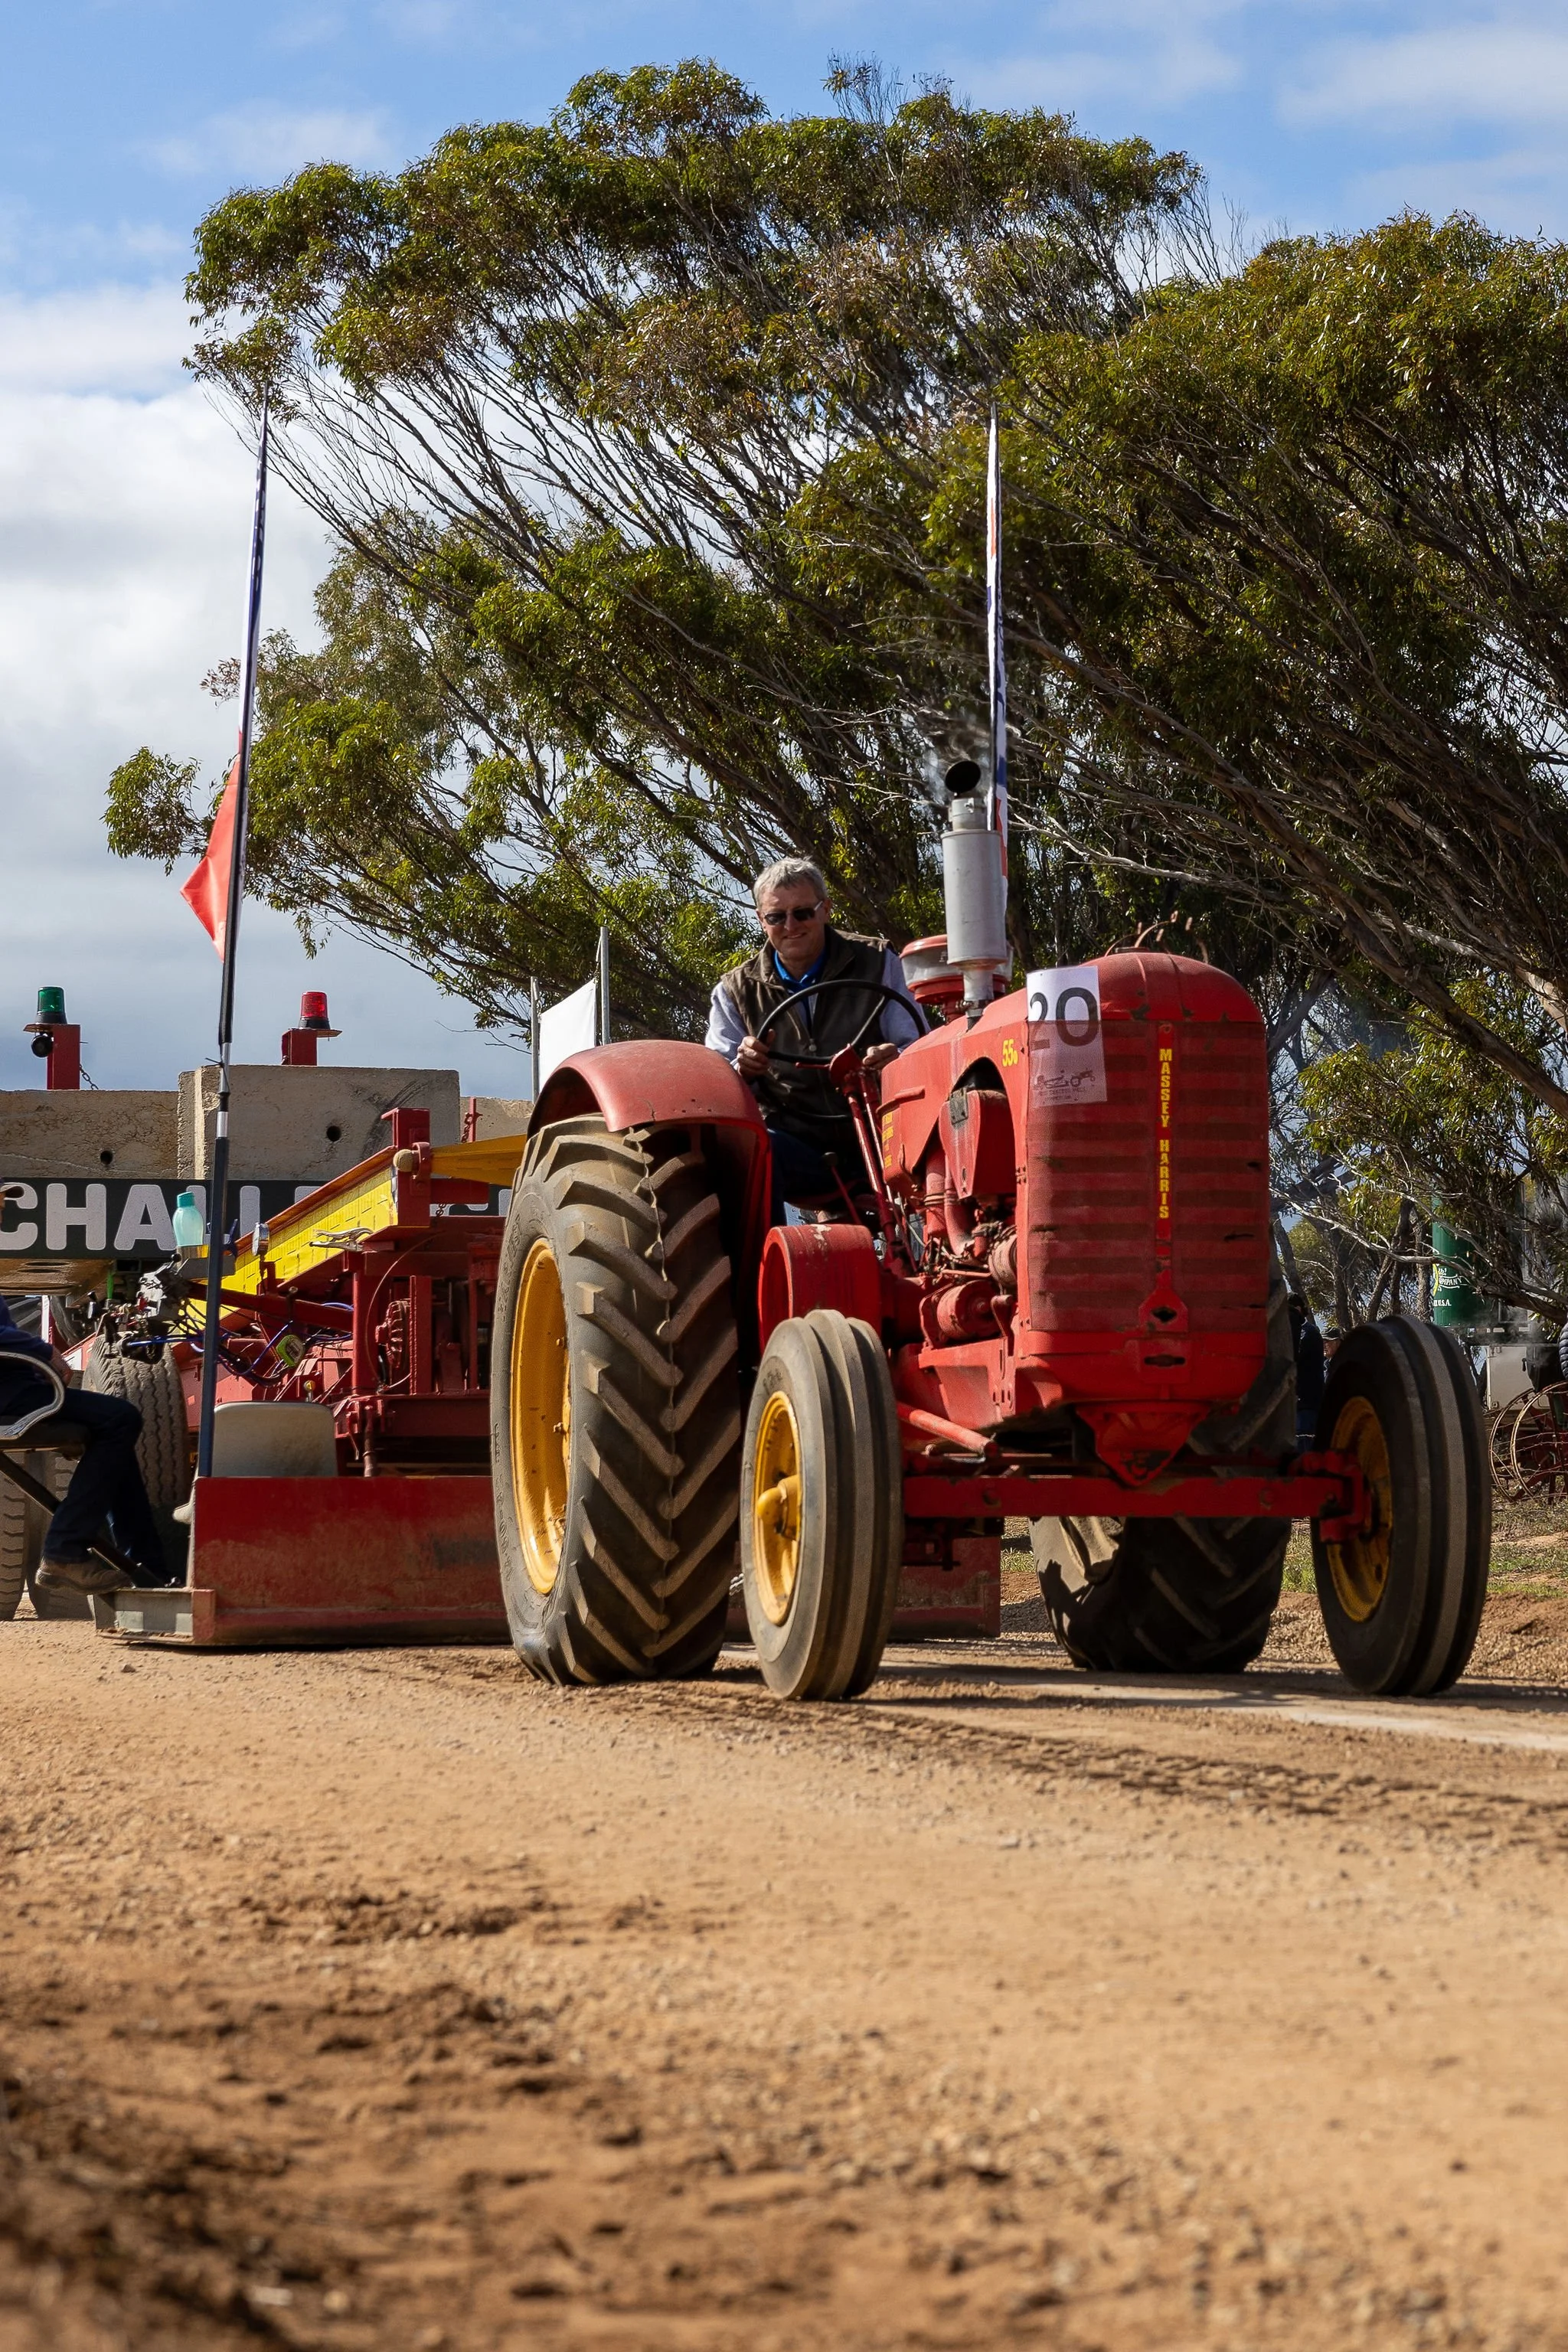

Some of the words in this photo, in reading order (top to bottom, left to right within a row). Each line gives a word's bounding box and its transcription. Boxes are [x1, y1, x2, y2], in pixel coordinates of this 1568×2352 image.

[1030, 987, 1099, 1050] 20
[1159, 1048, 1172, 1127] MASSEY
[1159, 1139, 1170, 1219] HARRIS
